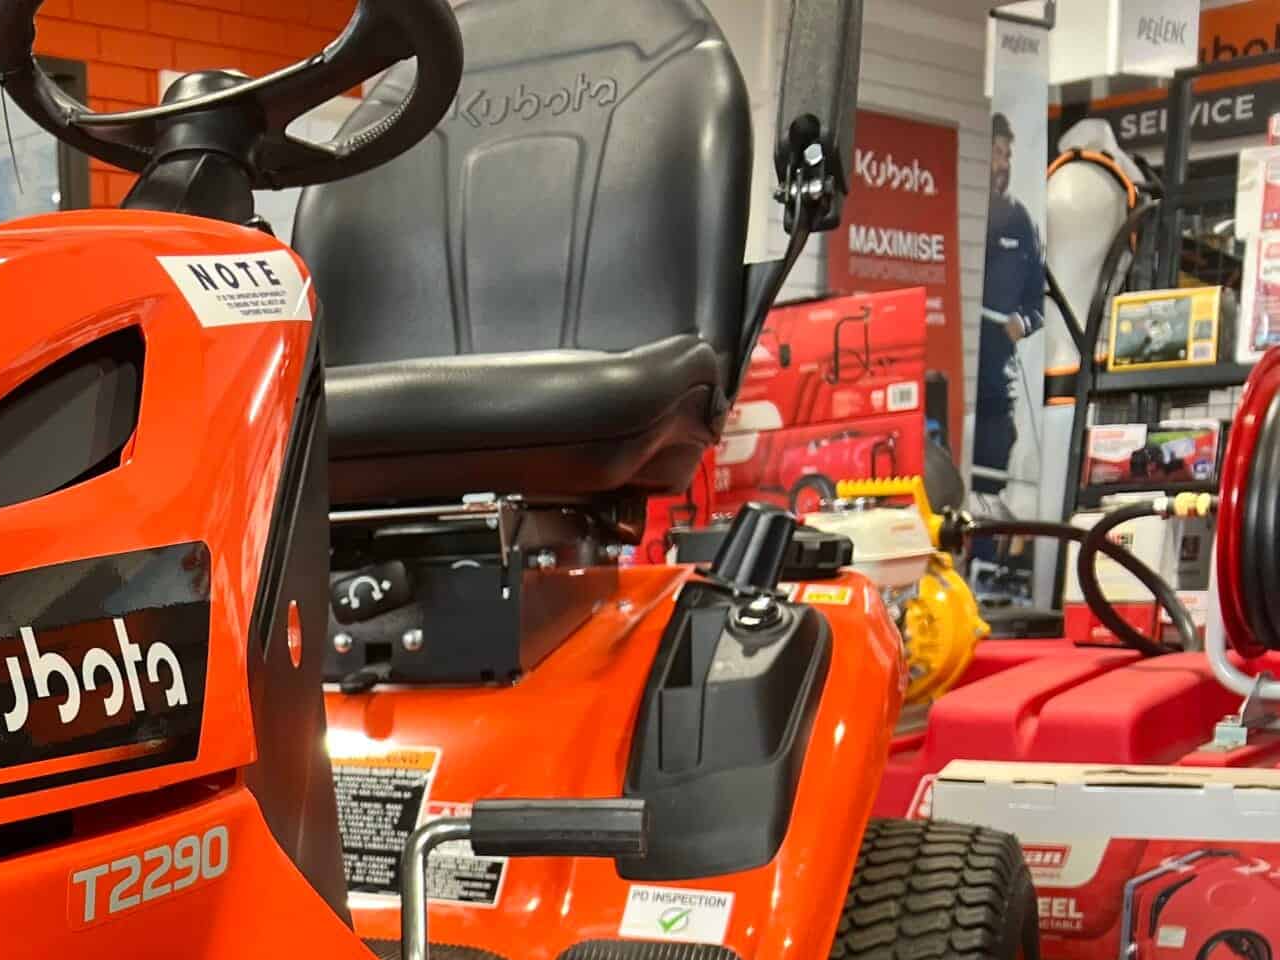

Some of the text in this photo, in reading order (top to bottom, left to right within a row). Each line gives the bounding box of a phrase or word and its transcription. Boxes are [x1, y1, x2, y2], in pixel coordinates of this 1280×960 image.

[448, 72, 618, 128] Kubota
[854, 148, 937, 195] Kubota
[849, 223, 945, 262] MAXIMISE
[187, 259, 281, 291] NOTE
[72, 825, 229, 922] T2290
[631, 889, 727, 907] PD INSPECTION
